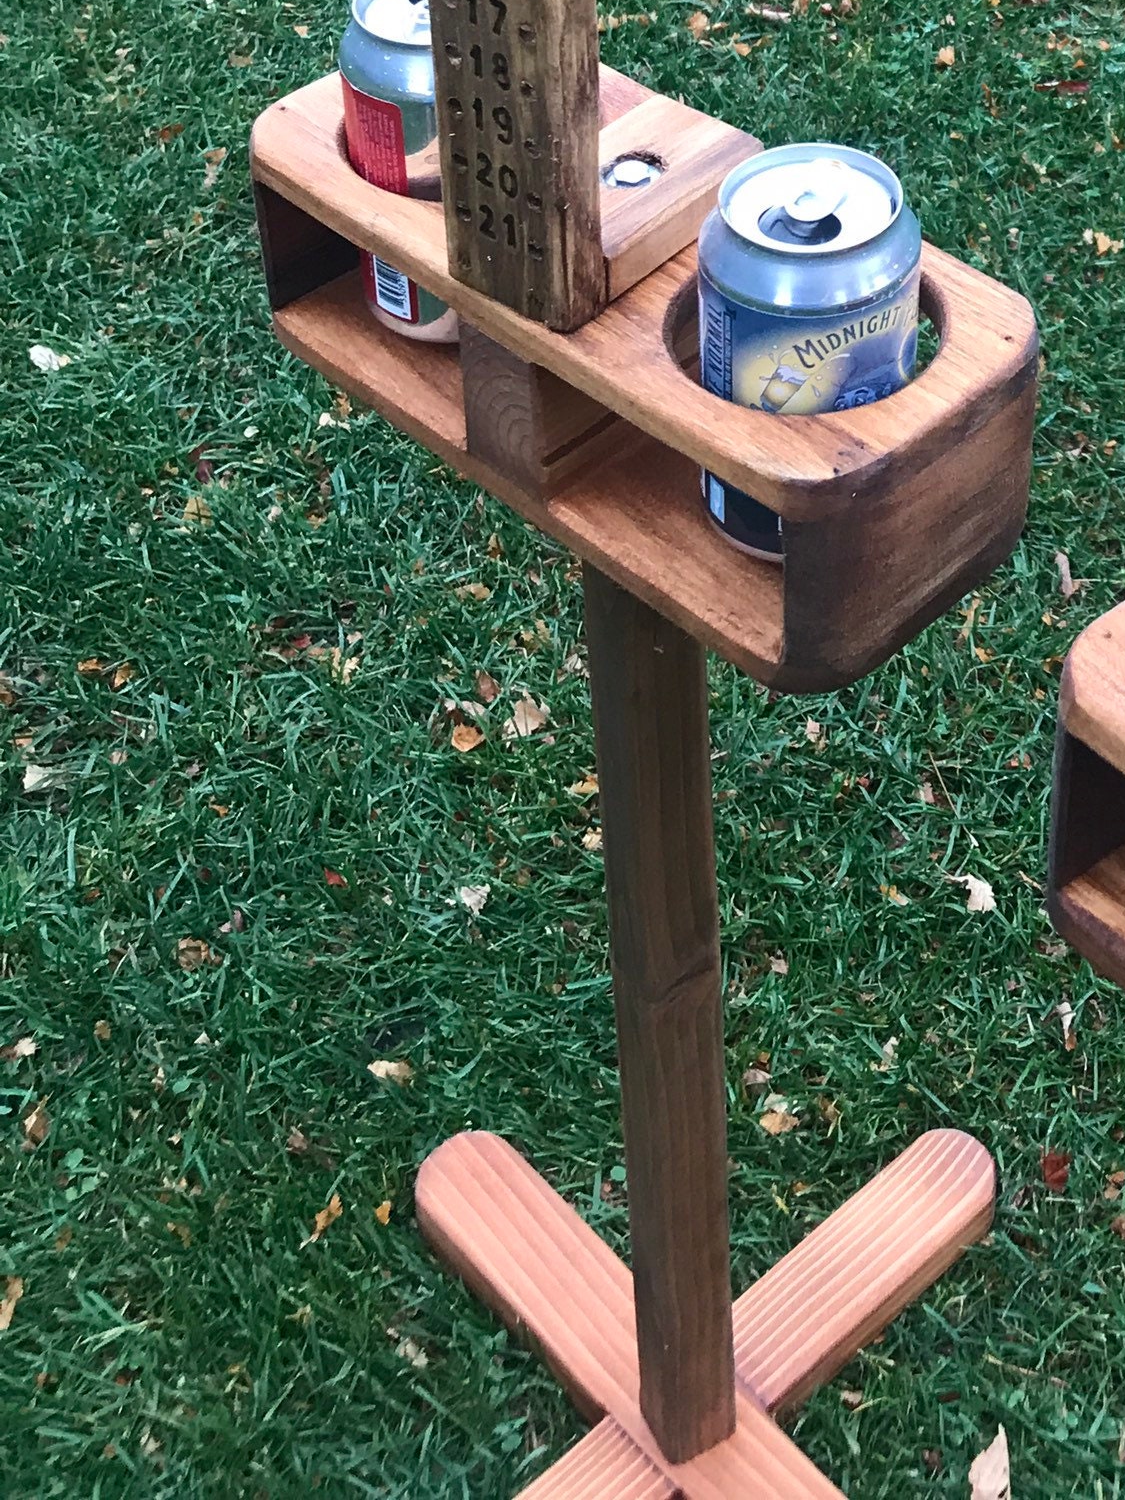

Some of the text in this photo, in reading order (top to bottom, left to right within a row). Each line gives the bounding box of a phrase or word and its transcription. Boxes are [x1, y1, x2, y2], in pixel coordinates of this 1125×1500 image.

[469, 44, 512, 91] 18
[471, 97, 513, 145] 19
[476, 152, 519, 199] 20
[478, 204, 517, 250] 21
[707, 303, 723, 378] NORMAL
[792, 306, 901, 369] MIDNIGHT
